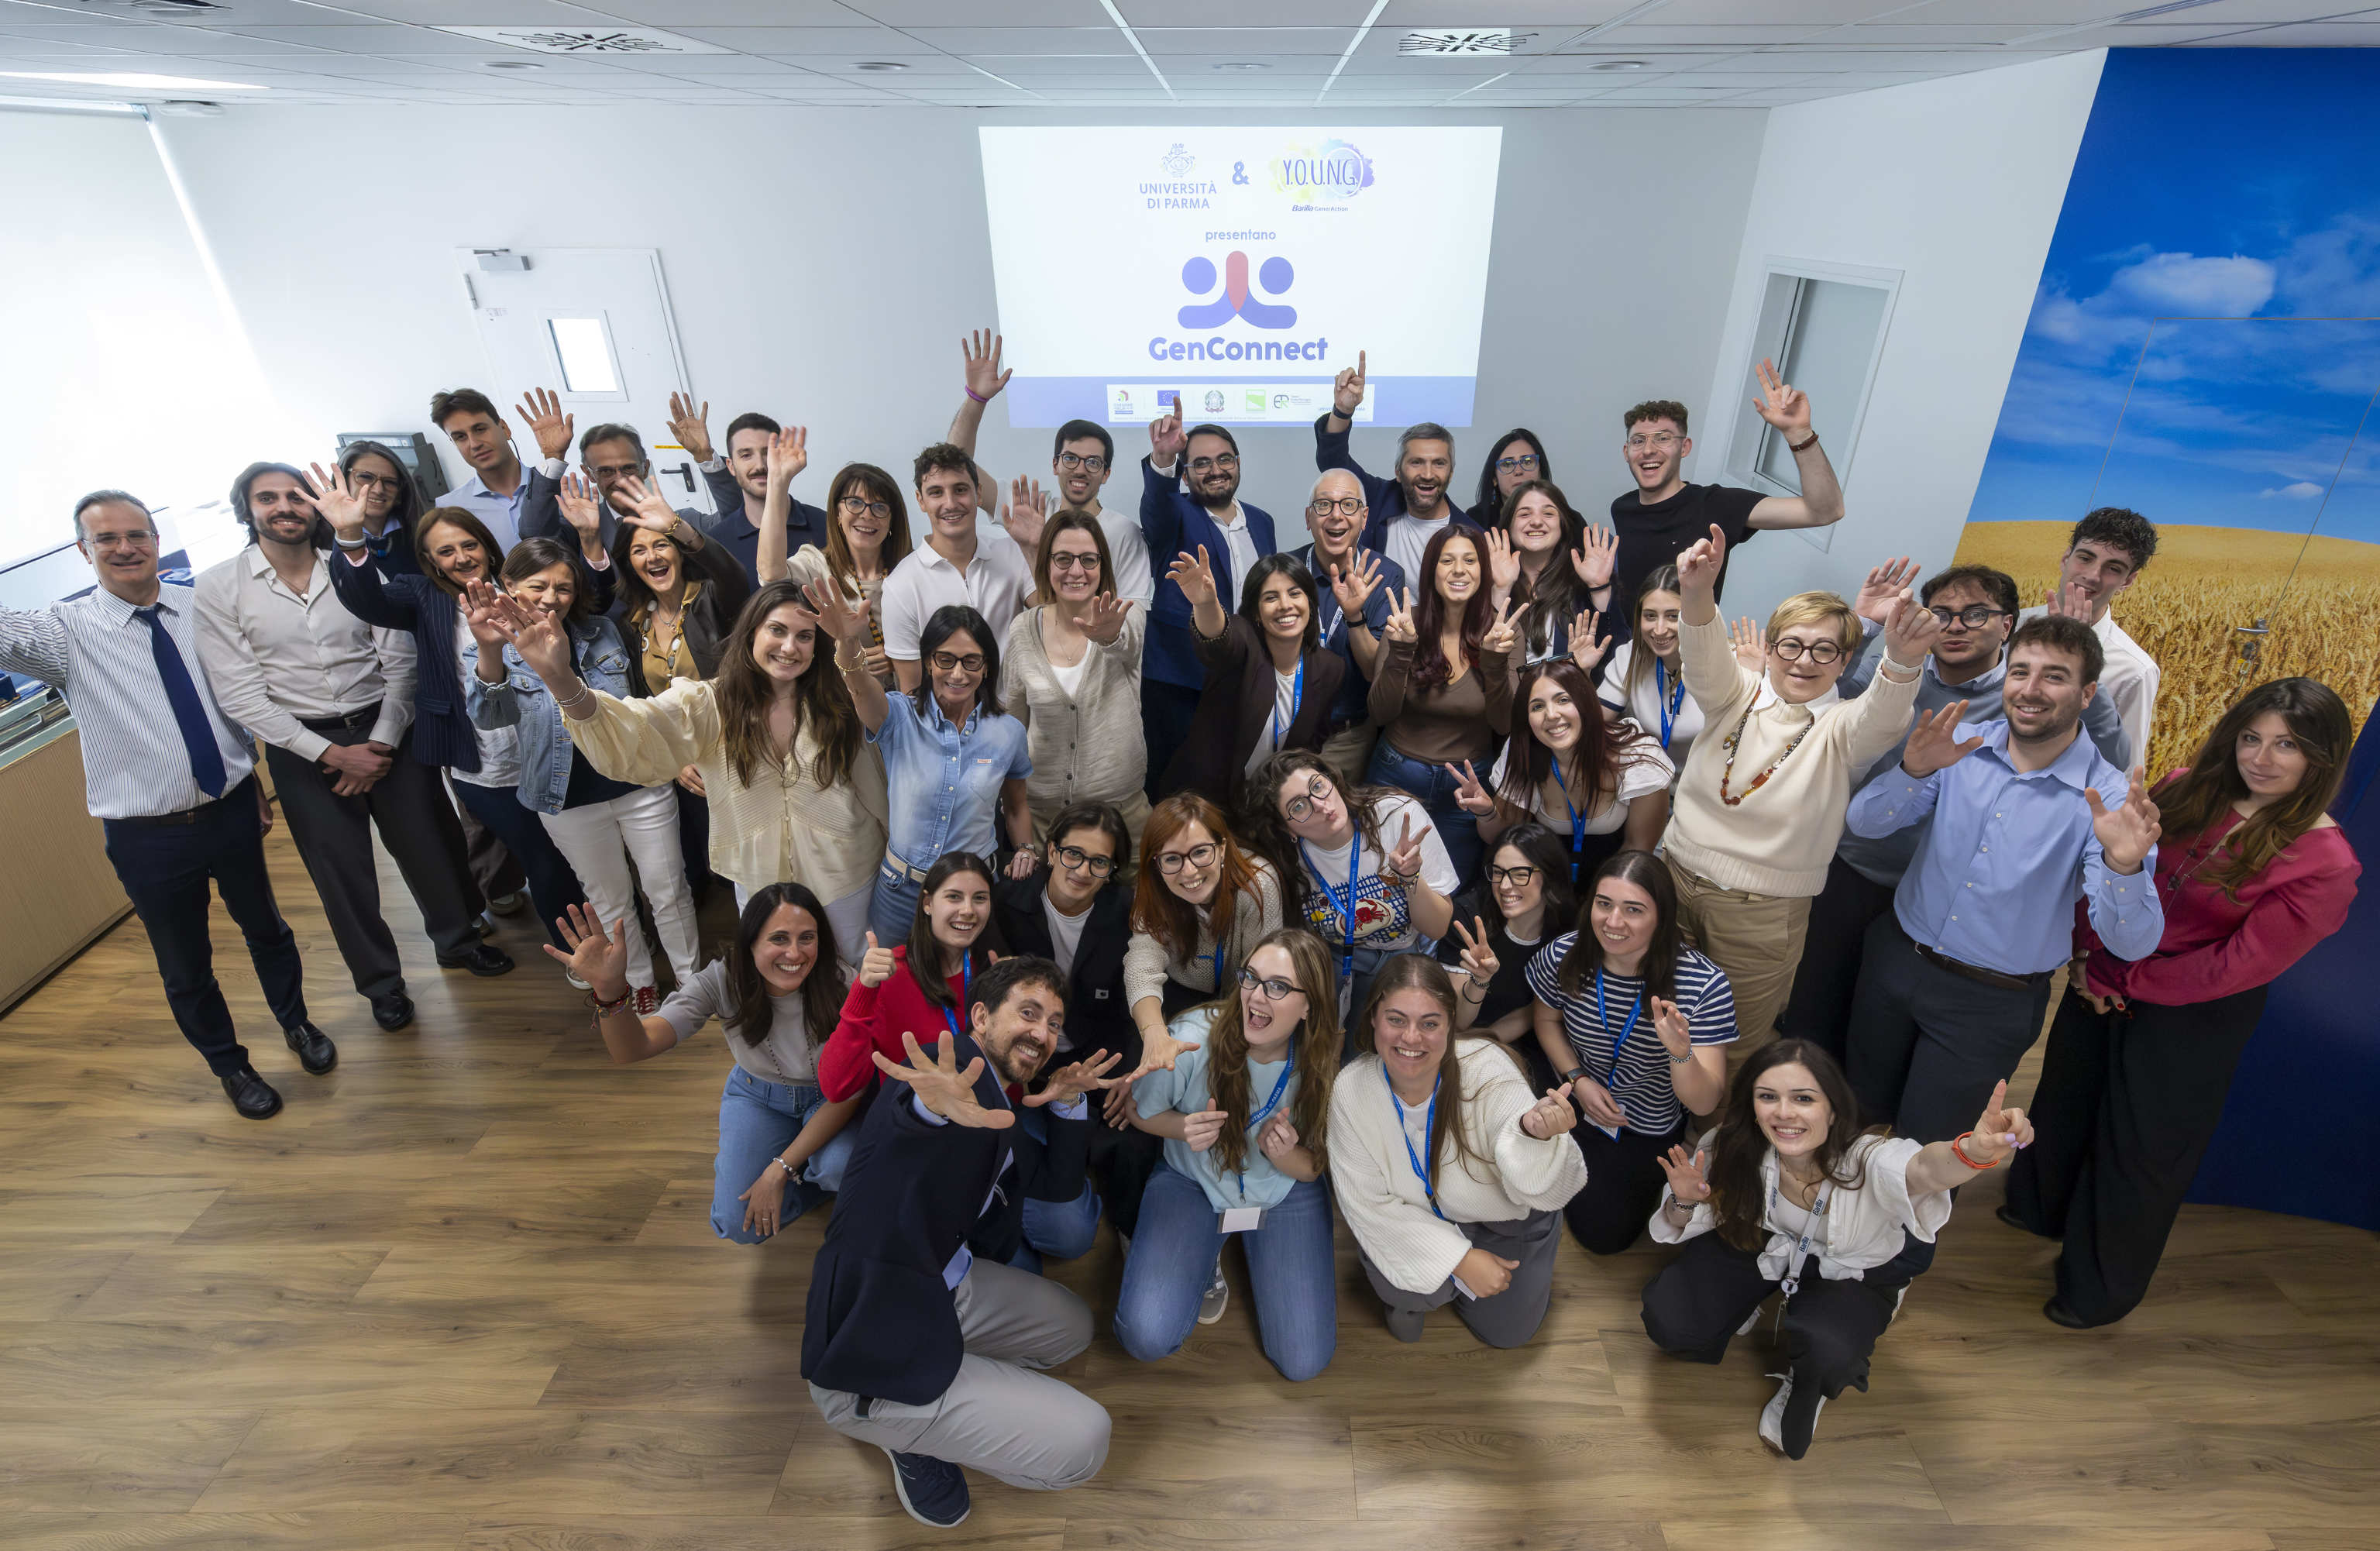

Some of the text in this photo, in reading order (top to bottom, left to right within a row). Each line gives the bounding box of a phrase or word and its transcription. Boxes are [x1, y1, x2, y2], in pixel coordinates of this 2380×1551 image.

[1232, 160, 1250, 185] &
[1283, 158, 1359, 186] Y.O.U.N.G.
[1140, 181, 1217, 194] UNIVERSITÀ
[1147, 198, 1210, 209] DI PARMA
[1205, 229, 1278, 242] presentano
[1148, 336, 1329, 361] GenConnect
[1812, 1198, 1824, 1216] Barilla
[1798, 1236, 1810, 1253] Barilla
